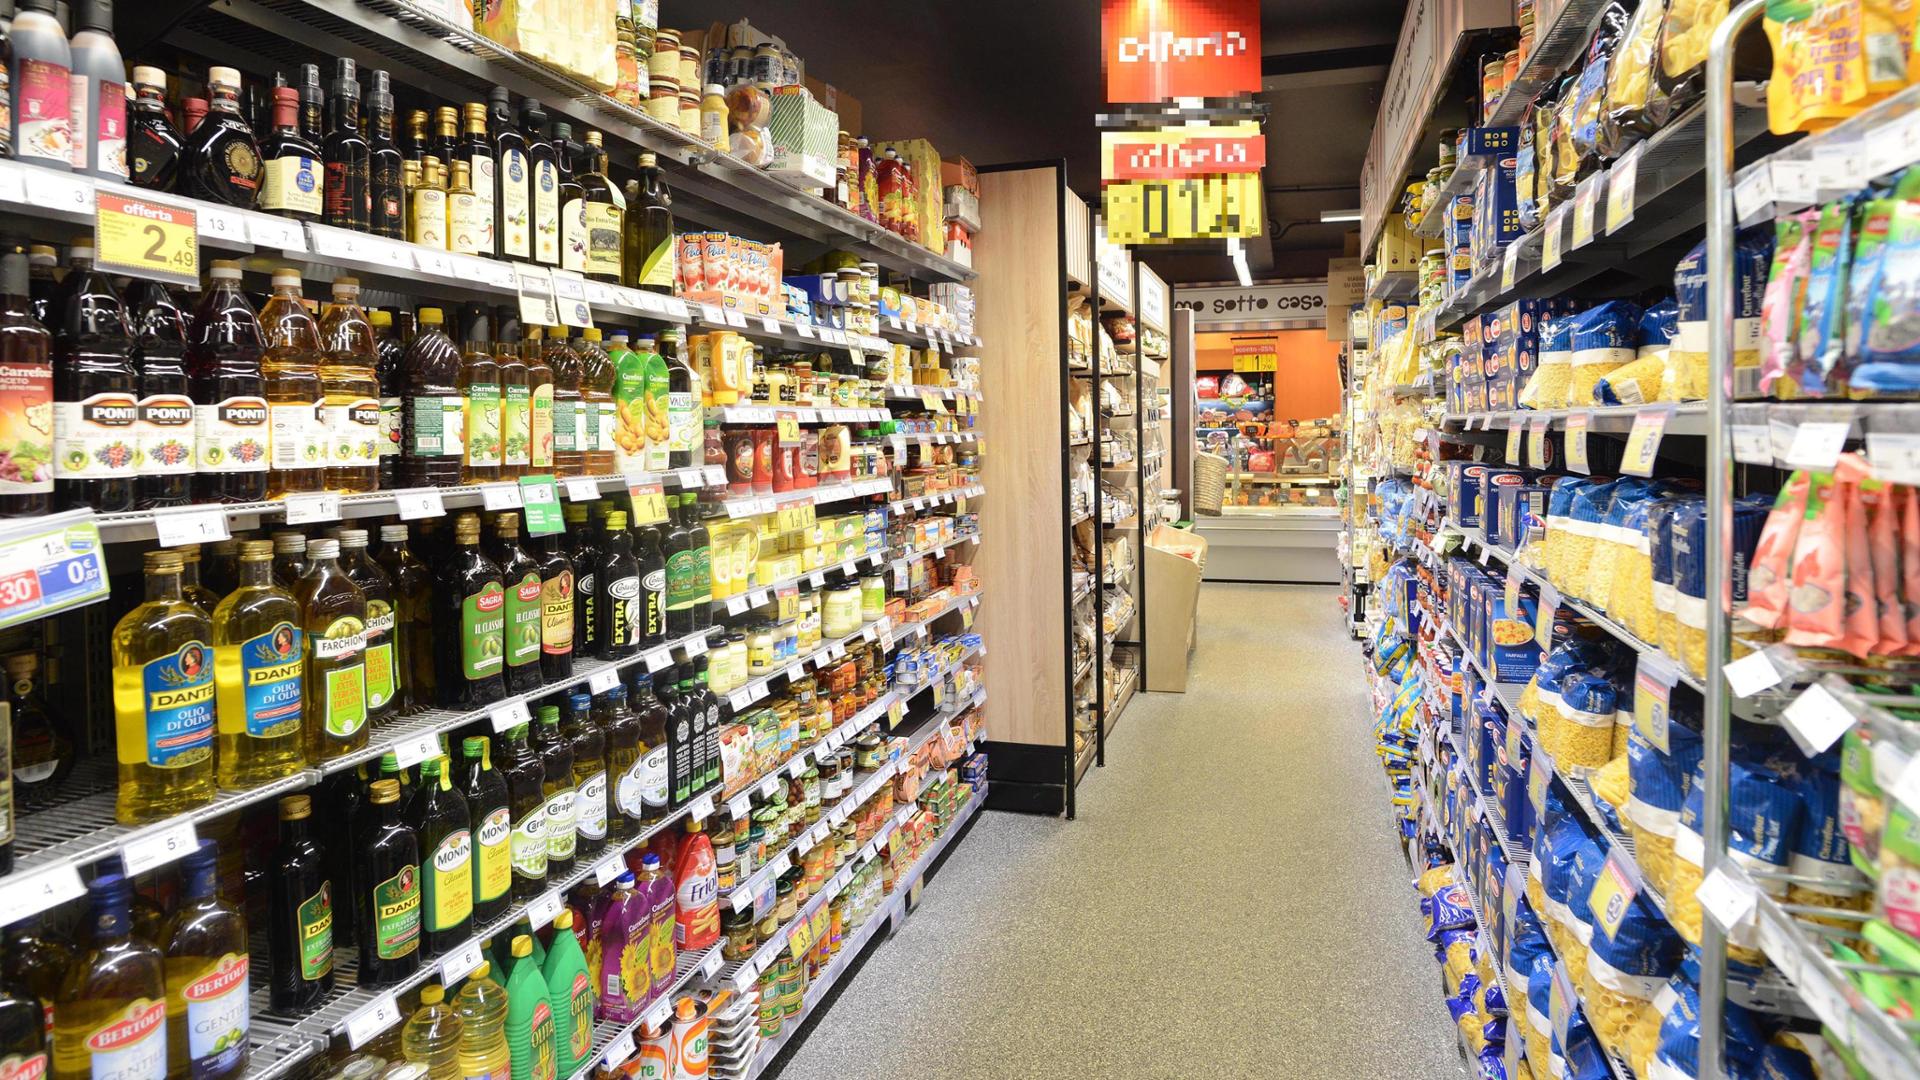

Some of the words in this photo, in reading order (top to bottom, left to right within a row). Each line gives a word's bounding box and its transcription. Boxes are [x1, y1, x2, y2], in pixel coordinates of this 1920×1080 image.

[123, 204, 173, 222] offerta
[1742, 275, 1752, 317] Carrefour
[1213, 294, 1269, 314] sotto
[1277, 295, 1328, 310] casa.
[93, 407, 136, 419] PONTI
[147, 408, 191, 419] PONTI
[226, 409, 265, 419] PONTI
[520, 586, 540, 597] SAGRA
[480, 594, 502, 607] SAGRA
[648, 592, 657, 634] EXTRA
[367, 615, 394, 628] CHIONI
[615, 600, 625, 644] EXTRA
[322, 634, 366, 652] FARCHIONI
[255, 664, 303, 681] DANTE
[272, 683, 296, 694] OLIO
[158, 685, 214, 706] DANTE
[263, 695, 275, 704] DI
[178, 706, 205, 720] OLIO
[512, 710, 519, 719] 5
[167, 721, 182, 731] DI
[420, 745, 427, 753] 6
[651, 894, 675, 912] Carrefour
[466, 954, 472, 964] 6
[377, 1008, 385, 1021] 5
[99, 1002, 165, 1046] BERTOLLI
